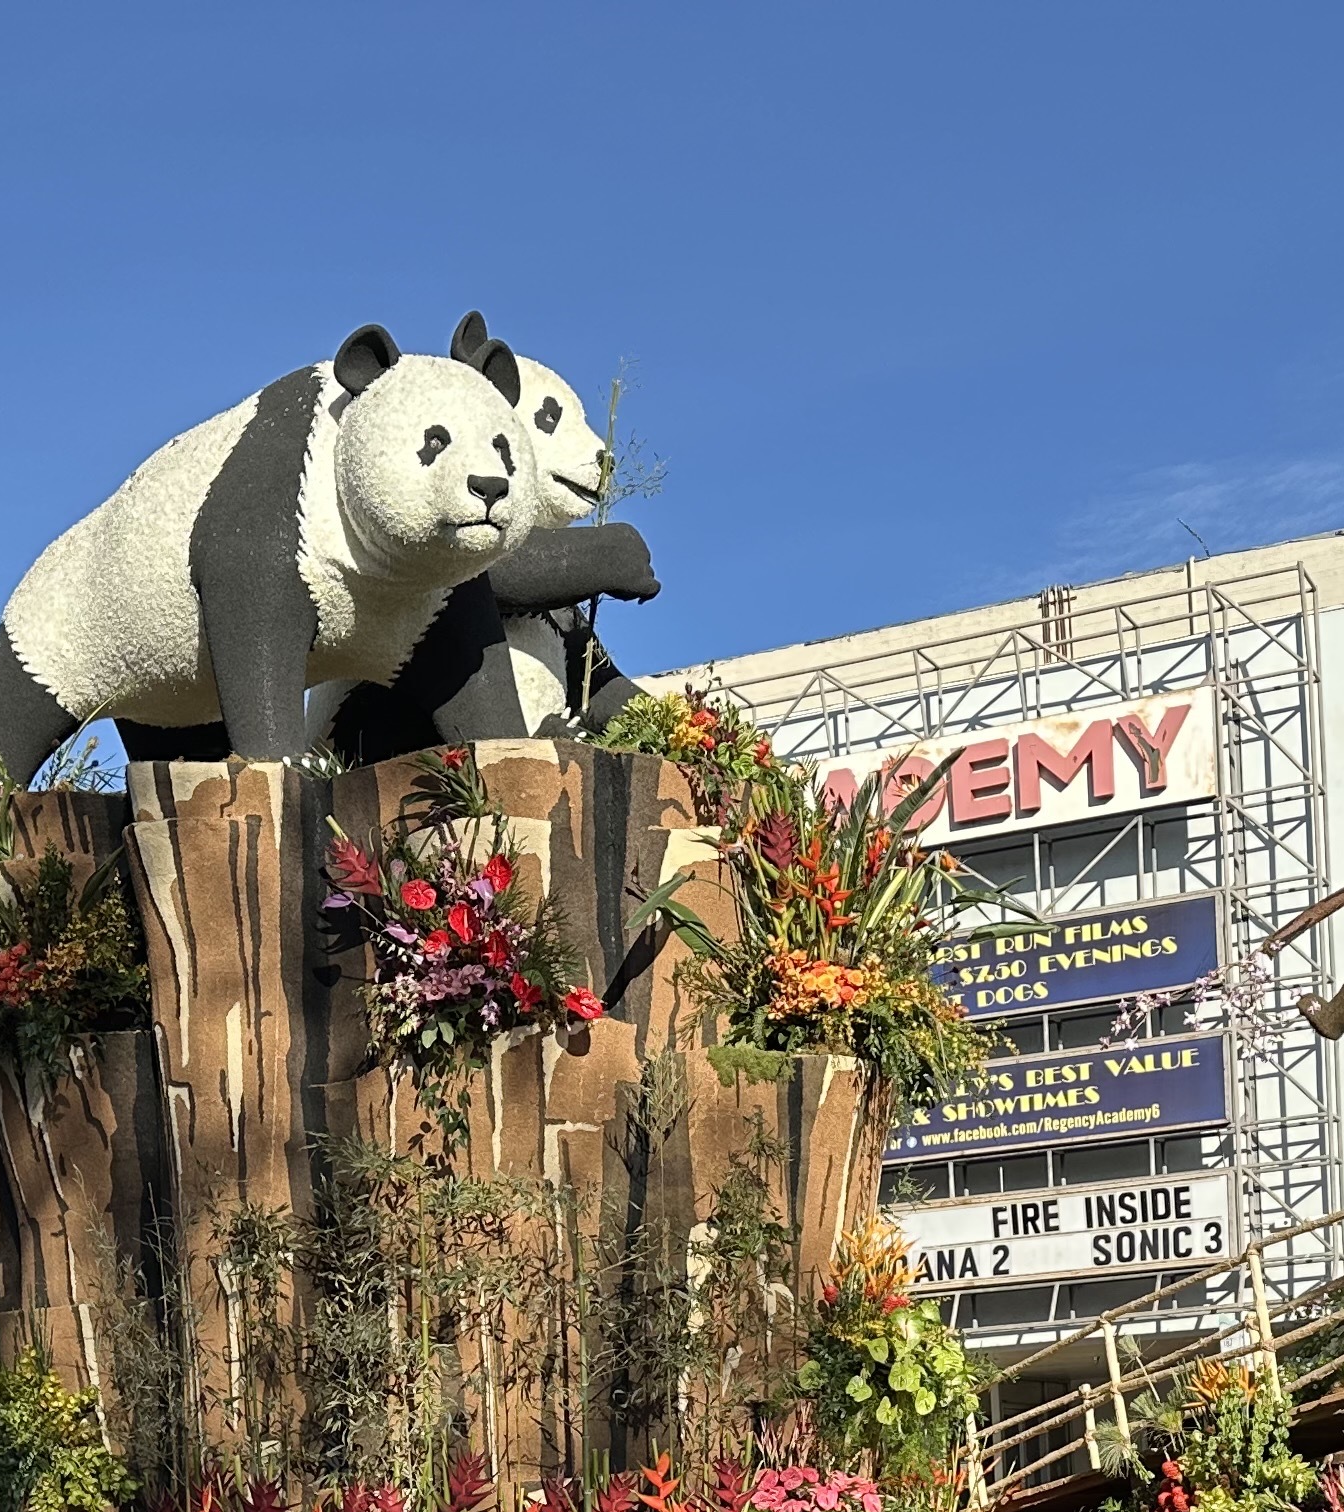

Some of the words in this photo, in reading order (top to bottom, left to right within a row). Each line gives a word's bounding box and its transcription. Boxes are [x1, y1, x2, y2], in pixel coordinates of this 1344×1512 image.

[995, 931, 1053, 956] RUN
[1064, 915, 1149, 945] FILMS
[959, 959, 1027, 987] $7.50
[1039, 936, 1178, 974] EVENINGS
[977, 982, 1049, 1009] DOGS
[1025, 1062, 1094, 1088] BEST
[1104, 1048, 1201, 1077] VALUE
[912, 1108, 931, 1126] &
[942, 1085, 1101, 1123] SHOWTIMES
[921, 1103, 1161, 1148] www.facebook.com/RegencyAcademy6
[992, 1200, 1060, 1238] FIRE
[1084, 1186, 1192, 1228] INSIDE
[992, 1244, 1010, 1276] 2
[1092, 1225, 1193, 1267] SONIC
[1204, 1221, 1223, 1255] 3
